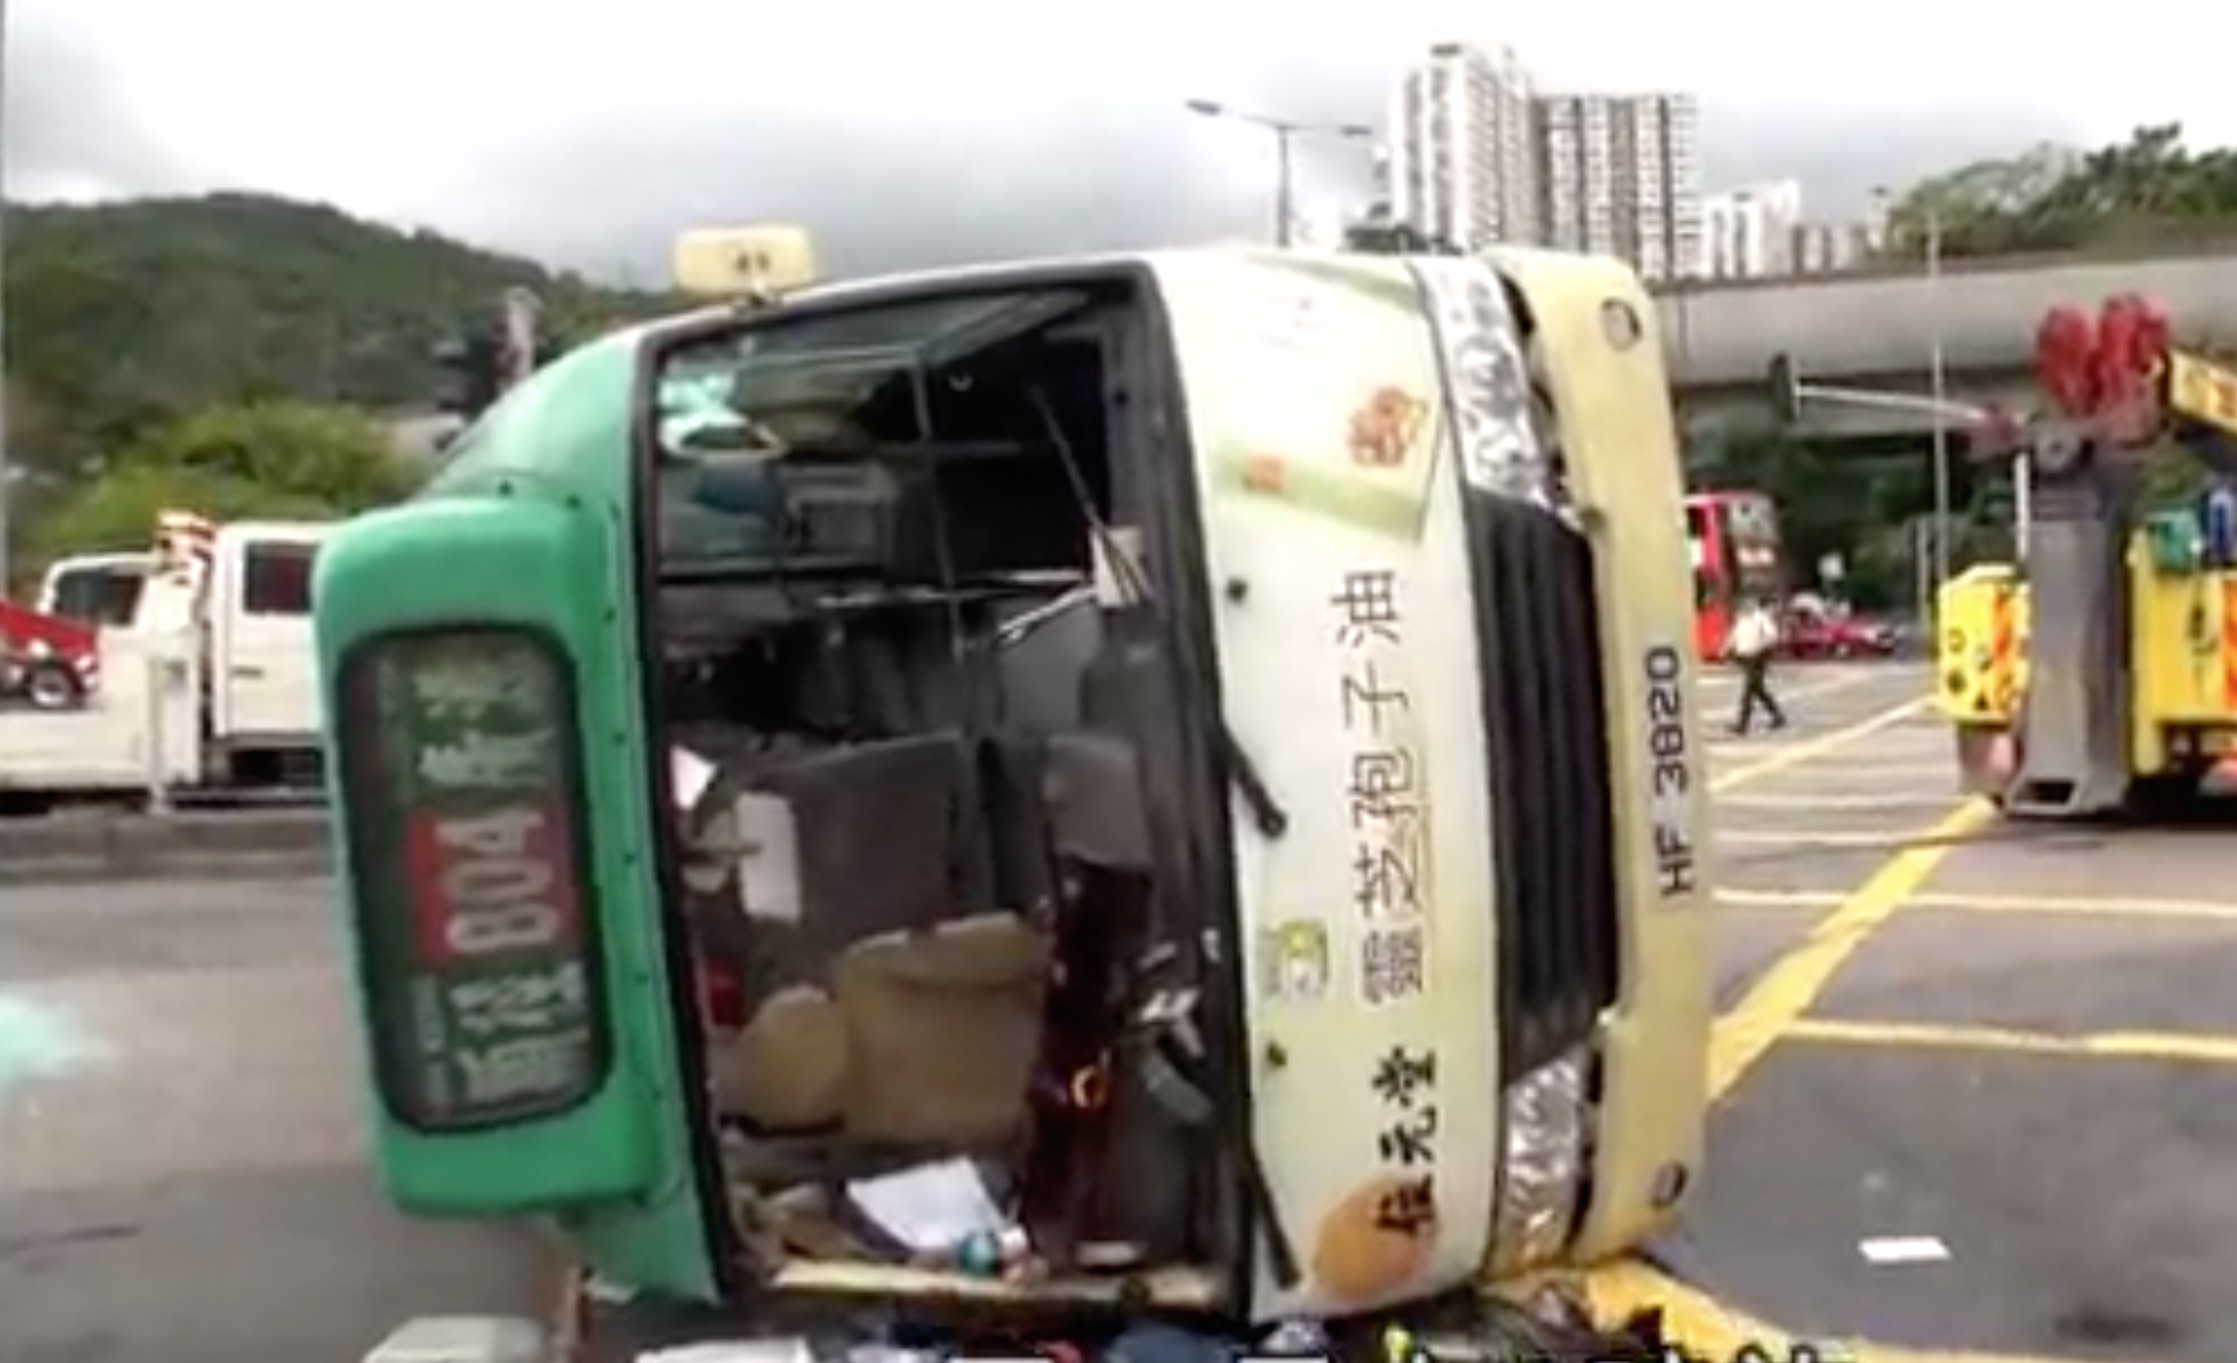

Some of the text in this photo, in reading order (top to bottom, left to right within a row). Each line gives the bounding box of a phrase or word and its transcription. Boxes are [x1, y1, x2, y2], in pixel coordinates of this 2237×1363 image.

[1330, 568, 1424, 1005] 靈芝孢子油
[1644, 645, 1694, 897] HF 3820
[1371, 1045, 1438, 1239] 位元堂
